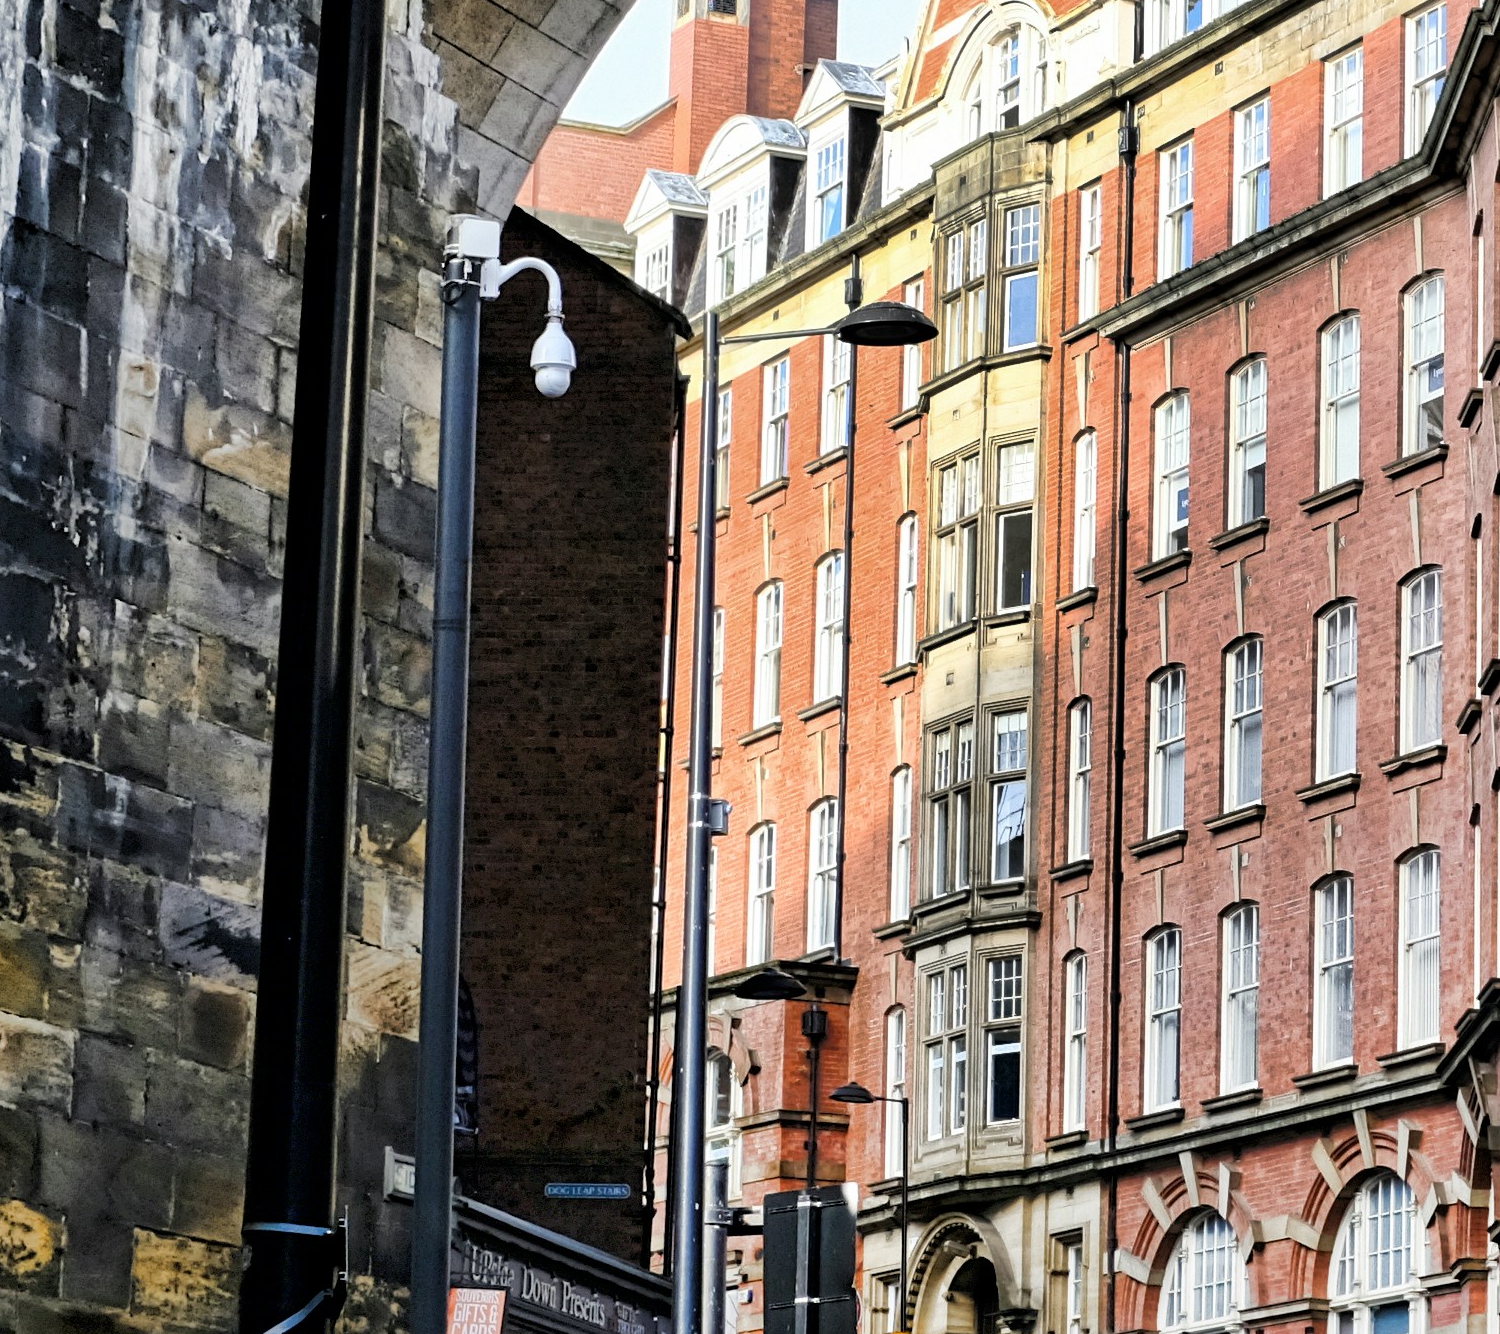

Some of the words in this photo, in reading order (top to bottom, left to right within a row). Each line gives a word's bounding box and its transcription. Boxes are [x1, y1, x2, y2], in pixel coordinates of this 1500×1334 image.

[547, 1186, 570, 1195] DOG
[572, 1186, 595, 1195] LEAP
[597, 1186, 629, 1195] STAIRS
[455, 1288, 500, 1305] SOUVENIRS
[521, 1266, 557, 1310] Down
[562, 1281, 606, 1327] Presents
[453, 1303, 487, 1324] GIFTS
[488, 1305, 498, 1324] &
